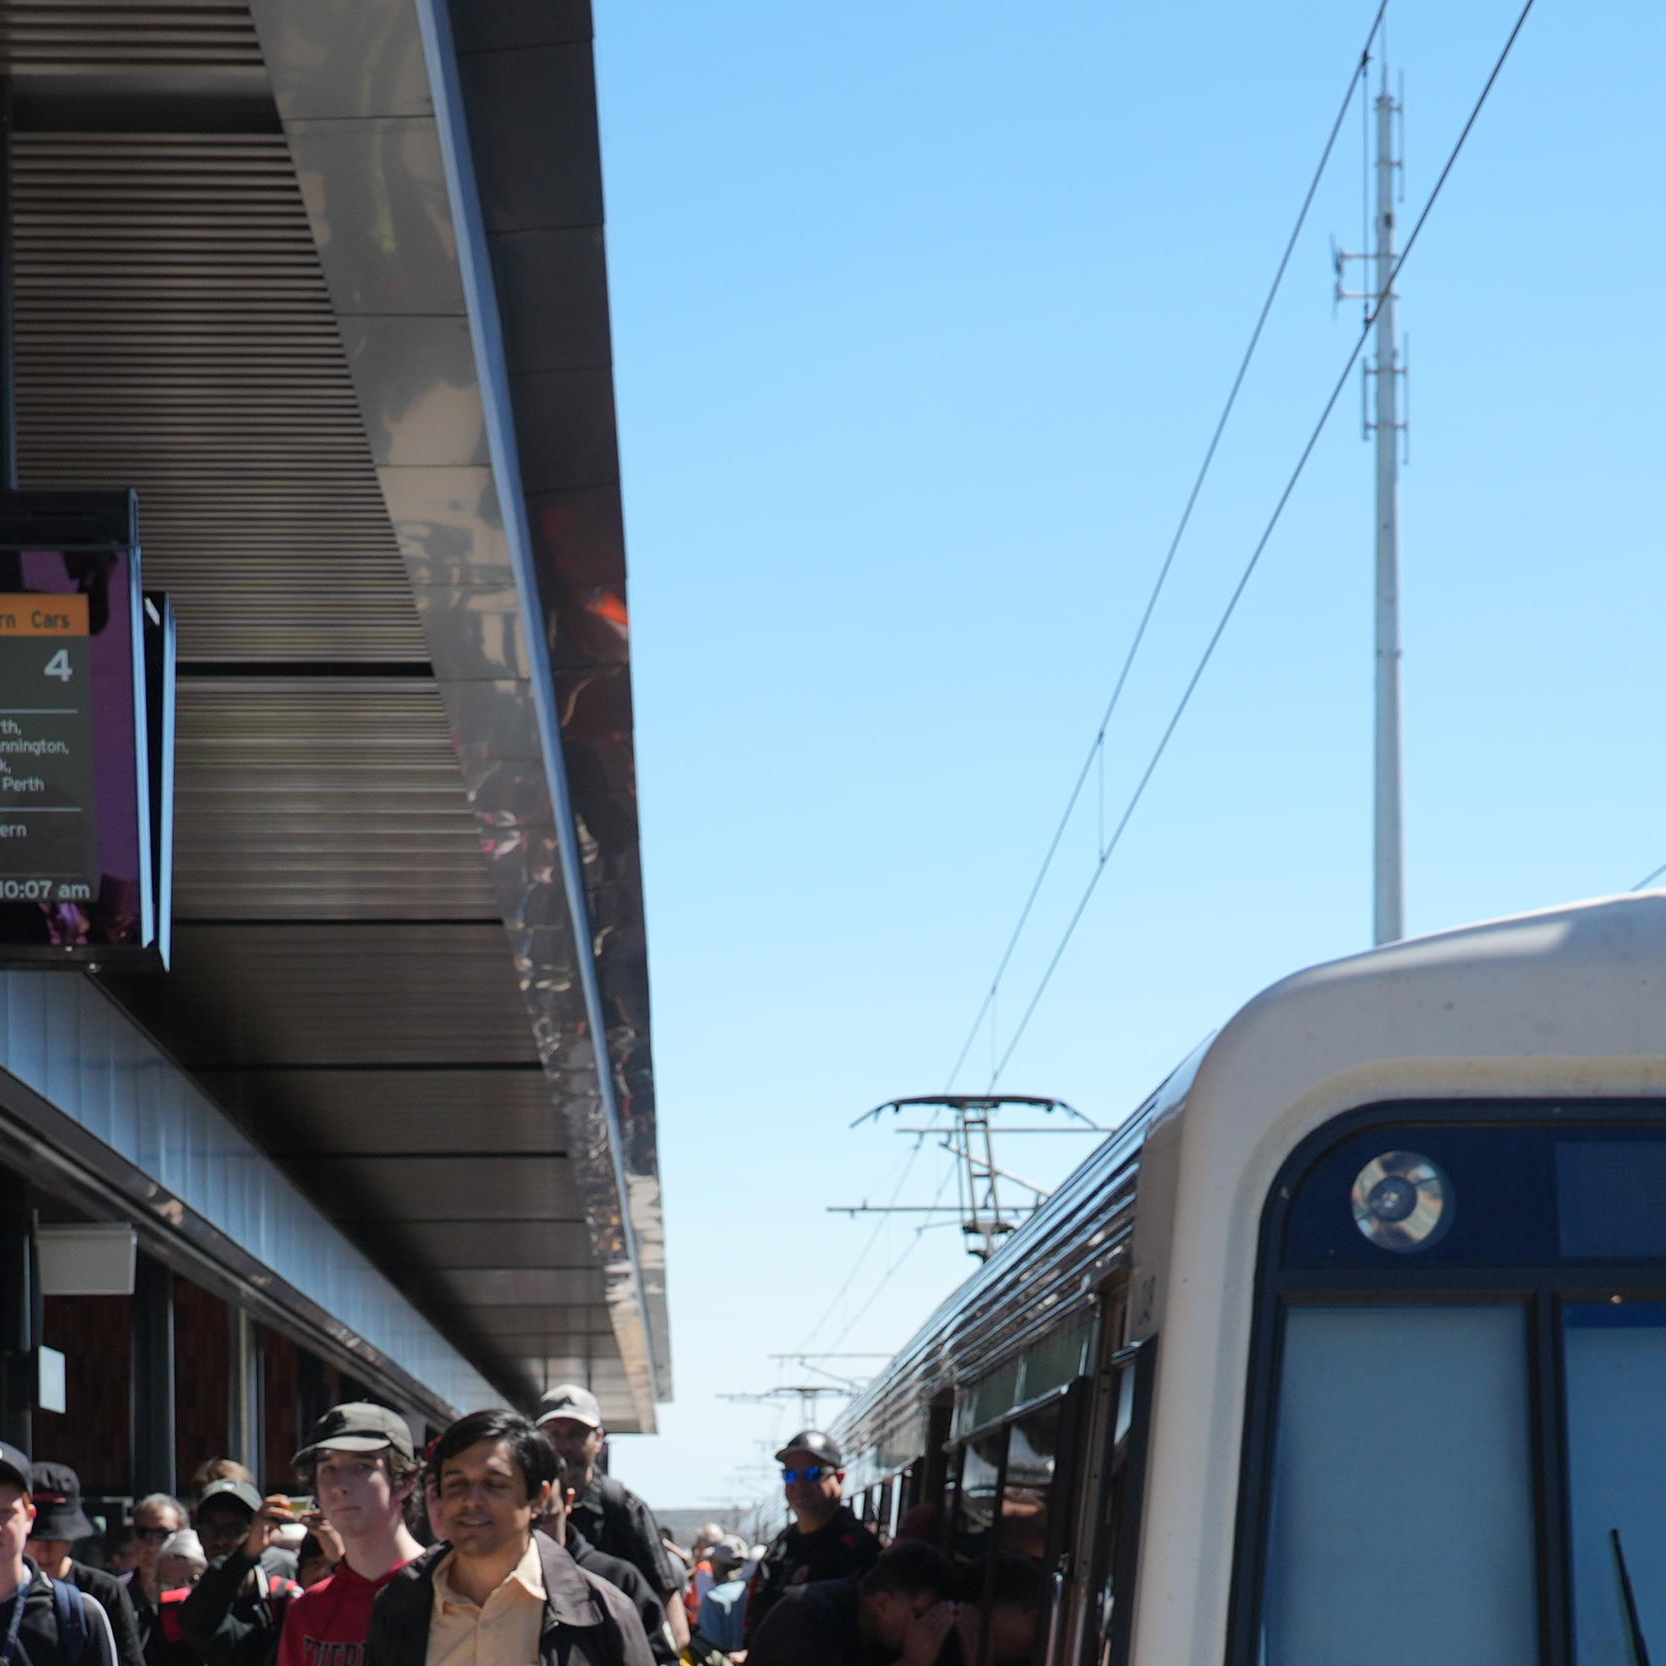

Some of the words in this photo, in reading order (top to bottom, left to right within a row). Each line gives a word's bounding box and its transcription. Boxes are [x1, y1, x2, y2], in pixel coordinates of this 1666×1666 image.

[31, 611, 71, 629] Cars
[44, 649, 73, 682] 4
[2, 776, 45, 792] Perth
[58, 883, 90, 899] am
